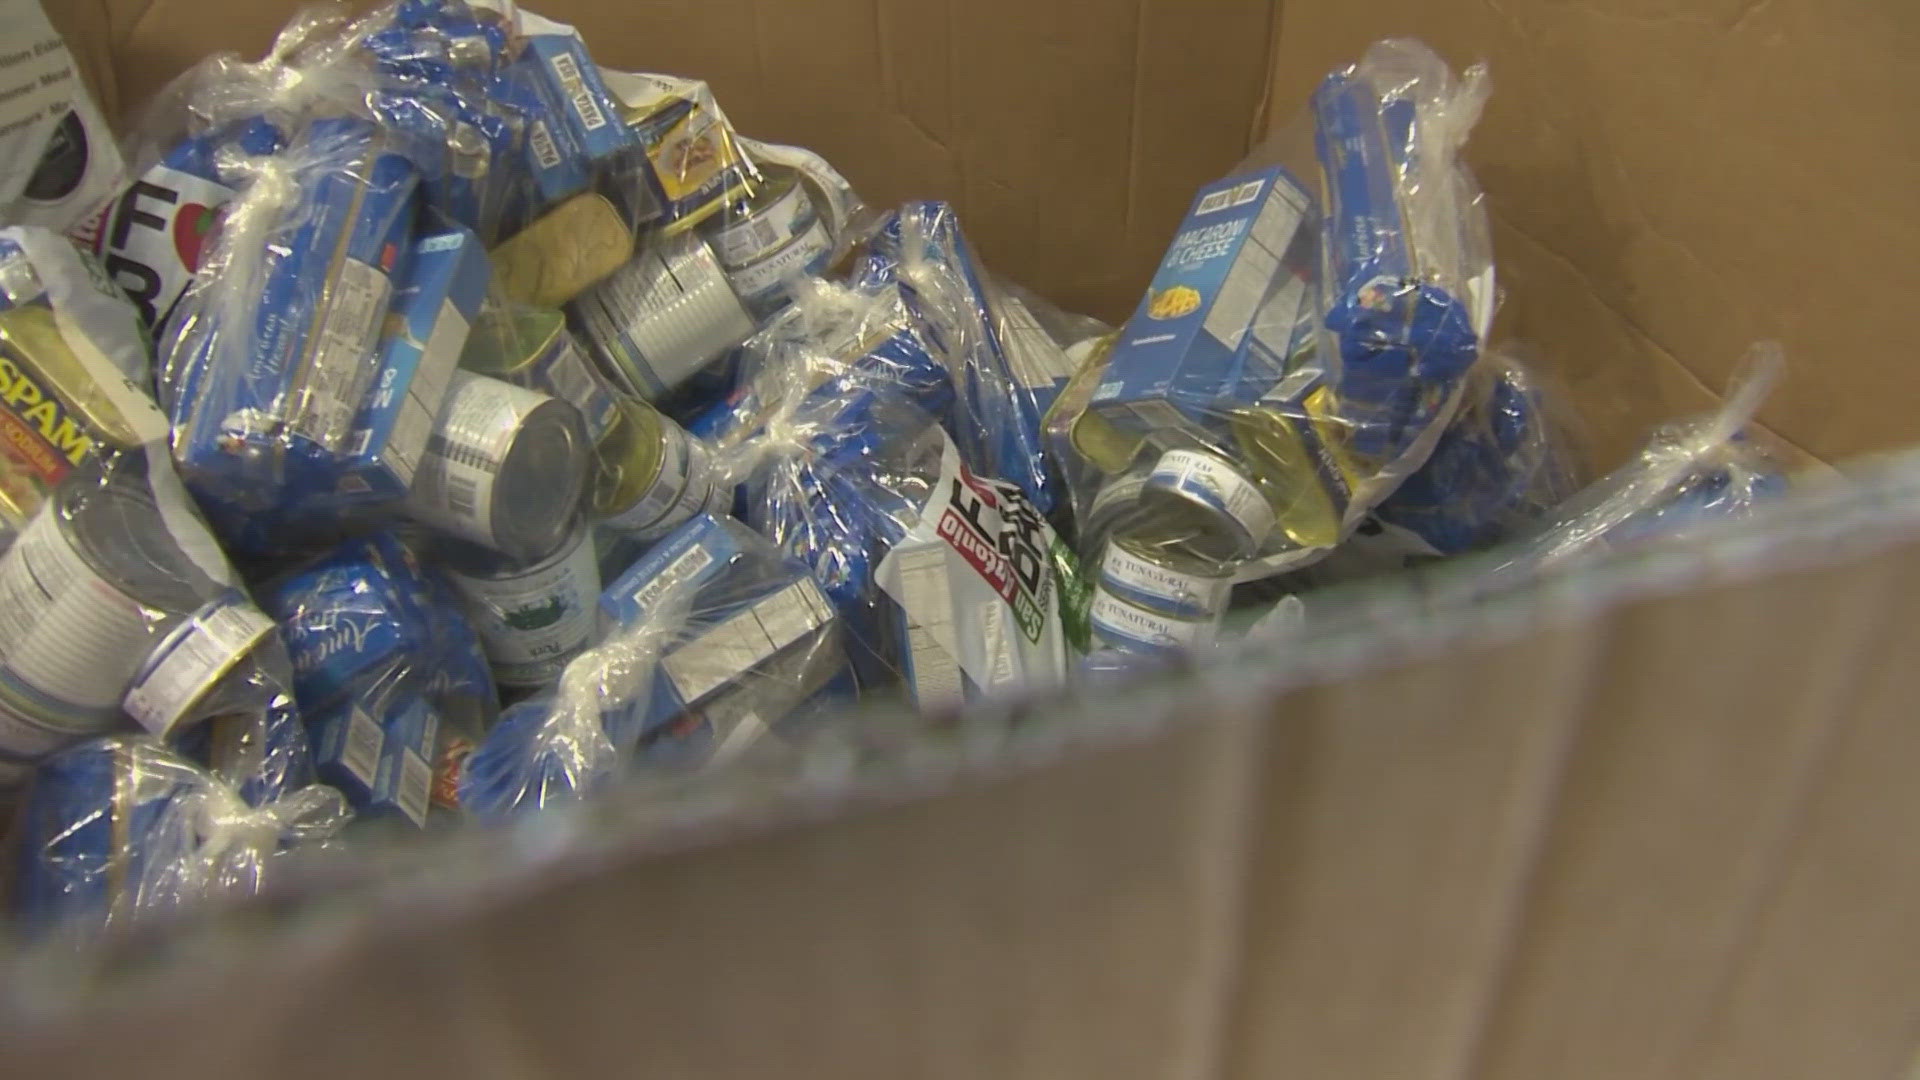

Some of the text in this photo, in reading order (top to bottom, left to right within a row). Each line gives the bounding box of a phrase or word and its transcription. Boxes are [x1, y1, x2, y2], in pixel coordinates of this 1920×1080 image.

[1180, 237, 1235, 264] CHEESE
[0, 358, 93, 467] SPAM
[940, 513, 1015, 598] Antonio
[1015, 590, 1042, 642] San
[1108, 602, 1171, 636] TUNATURAL
